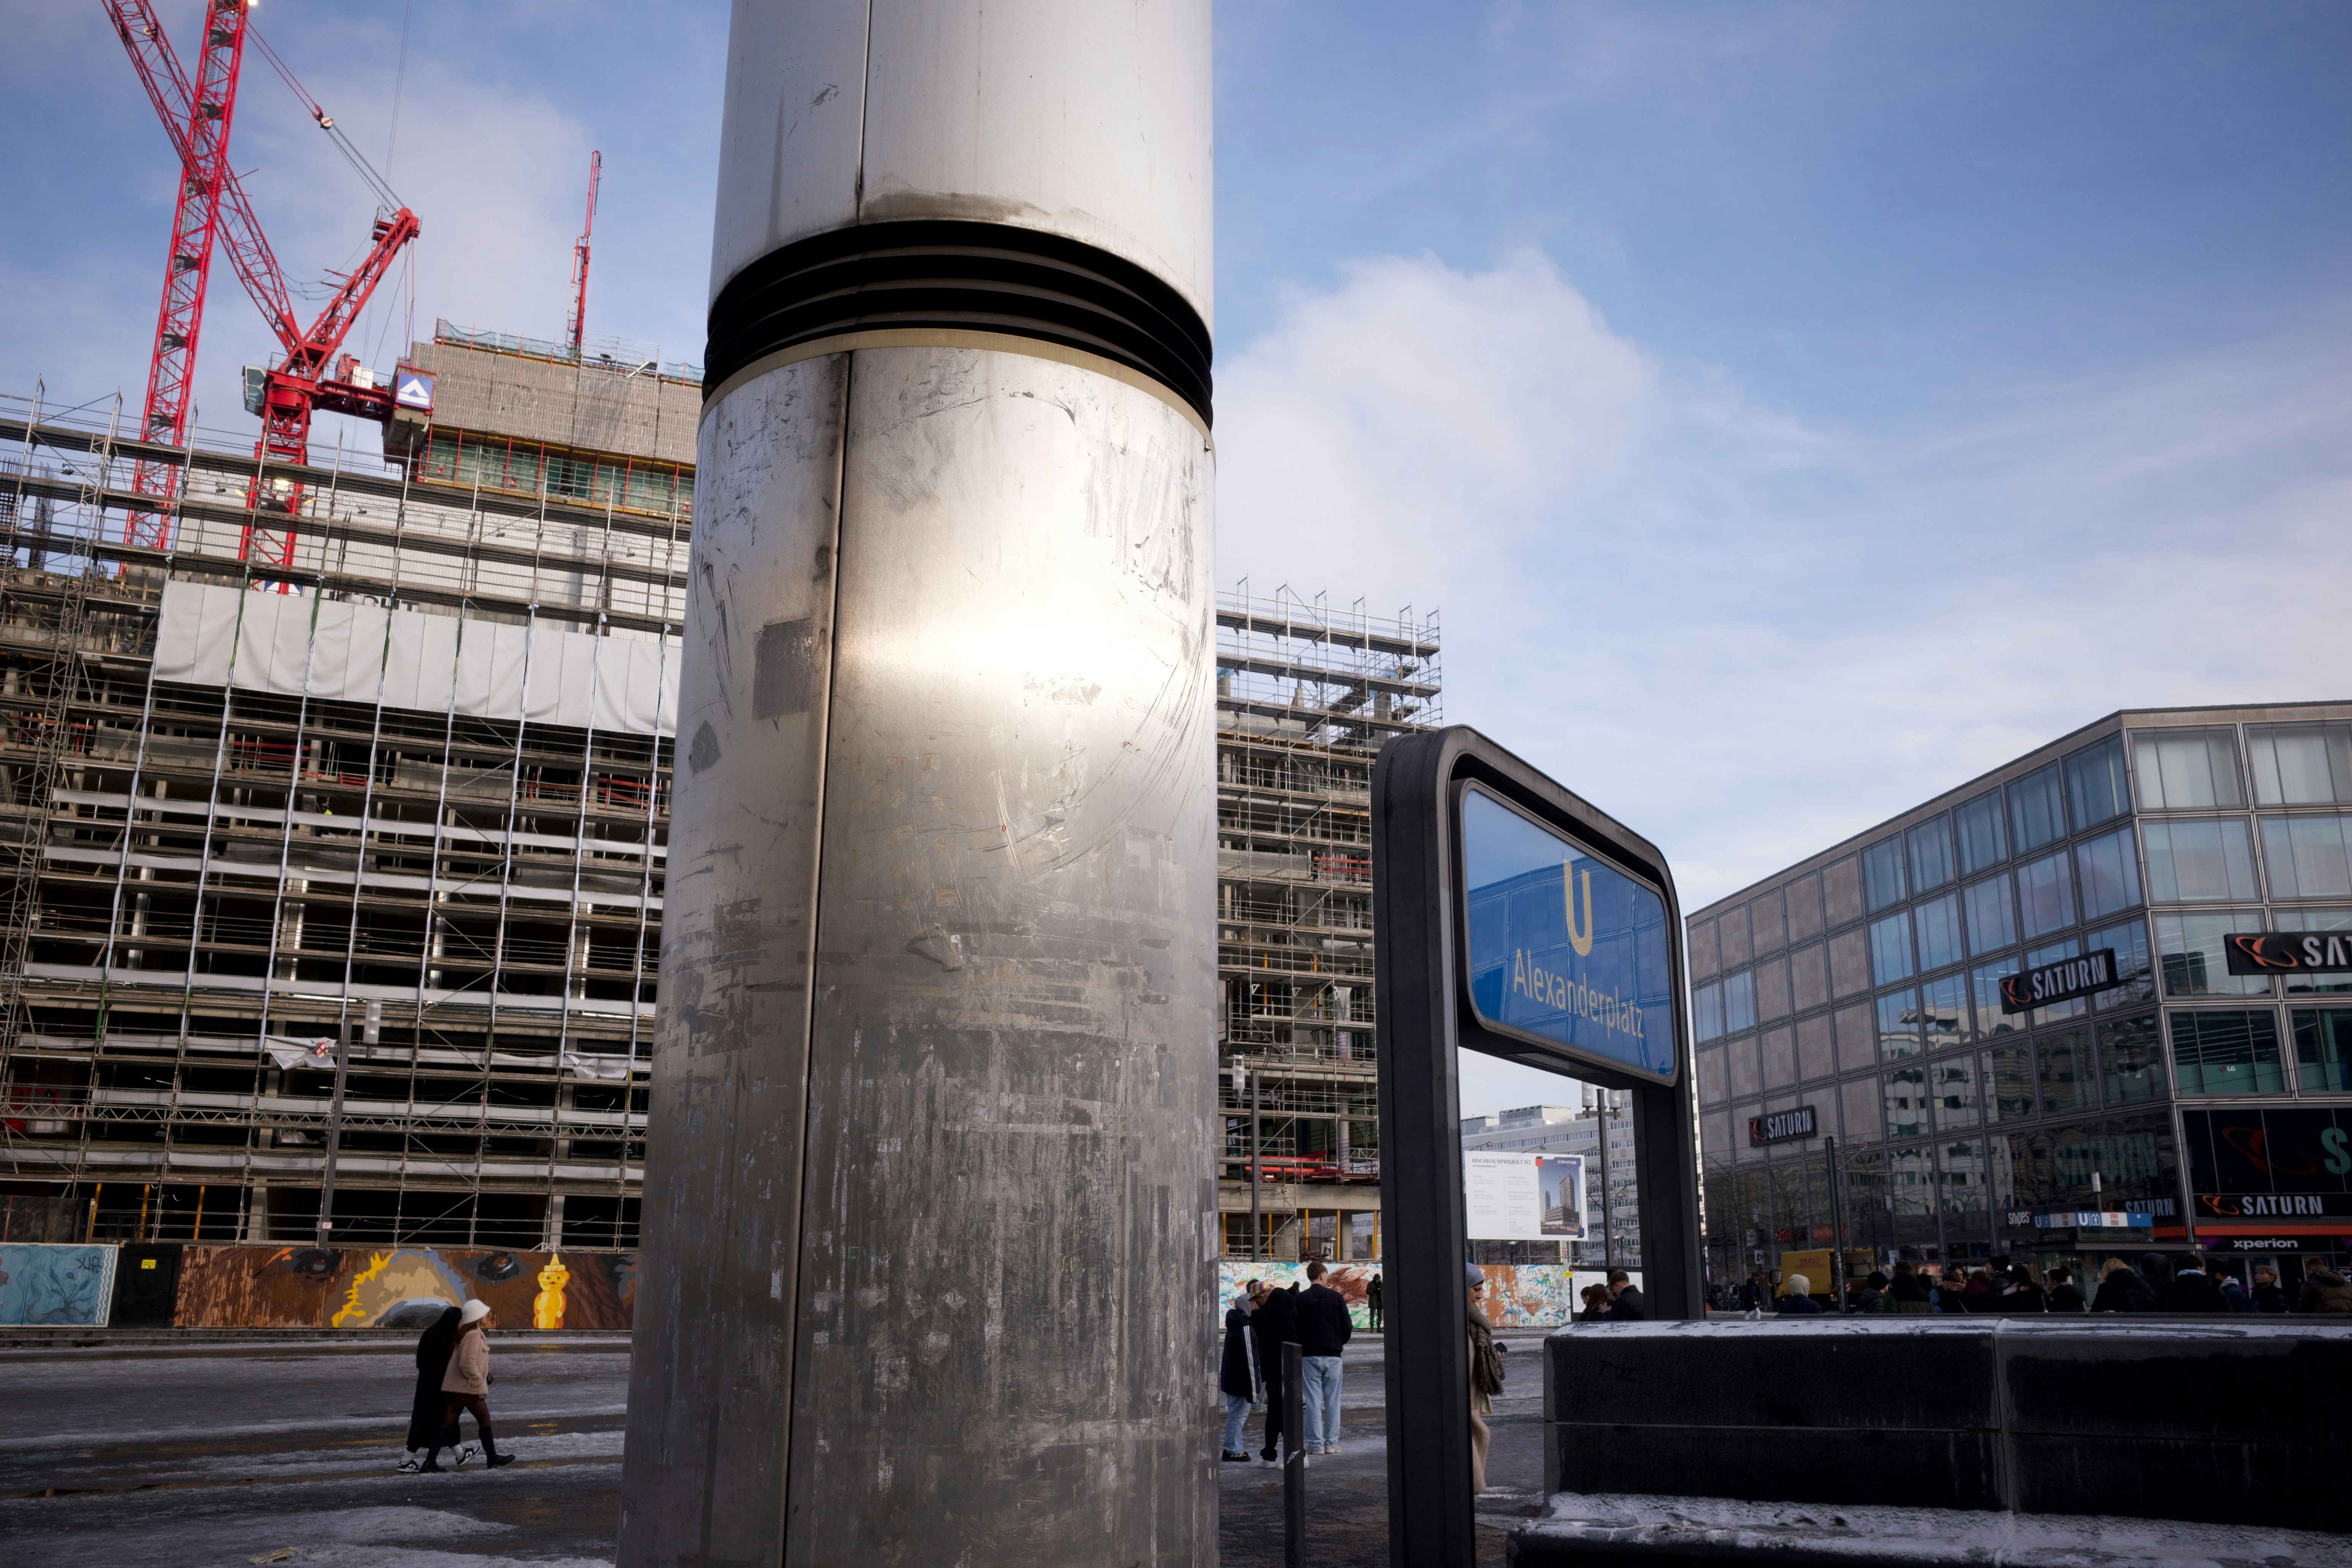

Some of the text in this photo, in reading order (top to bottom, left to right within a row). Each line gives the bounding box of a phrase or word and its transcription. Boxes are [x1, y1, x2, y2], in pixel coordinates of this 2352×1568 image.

[1563, 858, 1593, 957] U
[2032, 954, 2105, 1000] SATURN
[1513, 948, 1644, 1039] Alexanderplatz
[1767, 1110, 1811, 1139] SATURN
[2053, 1132, 2159, 1187] SATURN
[2125, 1198, 2175, 1217] SATURN
[2242, 1195, 2324, 1216] SATURN
[2034, 1215, 2042, 1228] U
[2078, 1212, 2088, 1226] U
[2233, 1238, 2298, 1250] xperion
